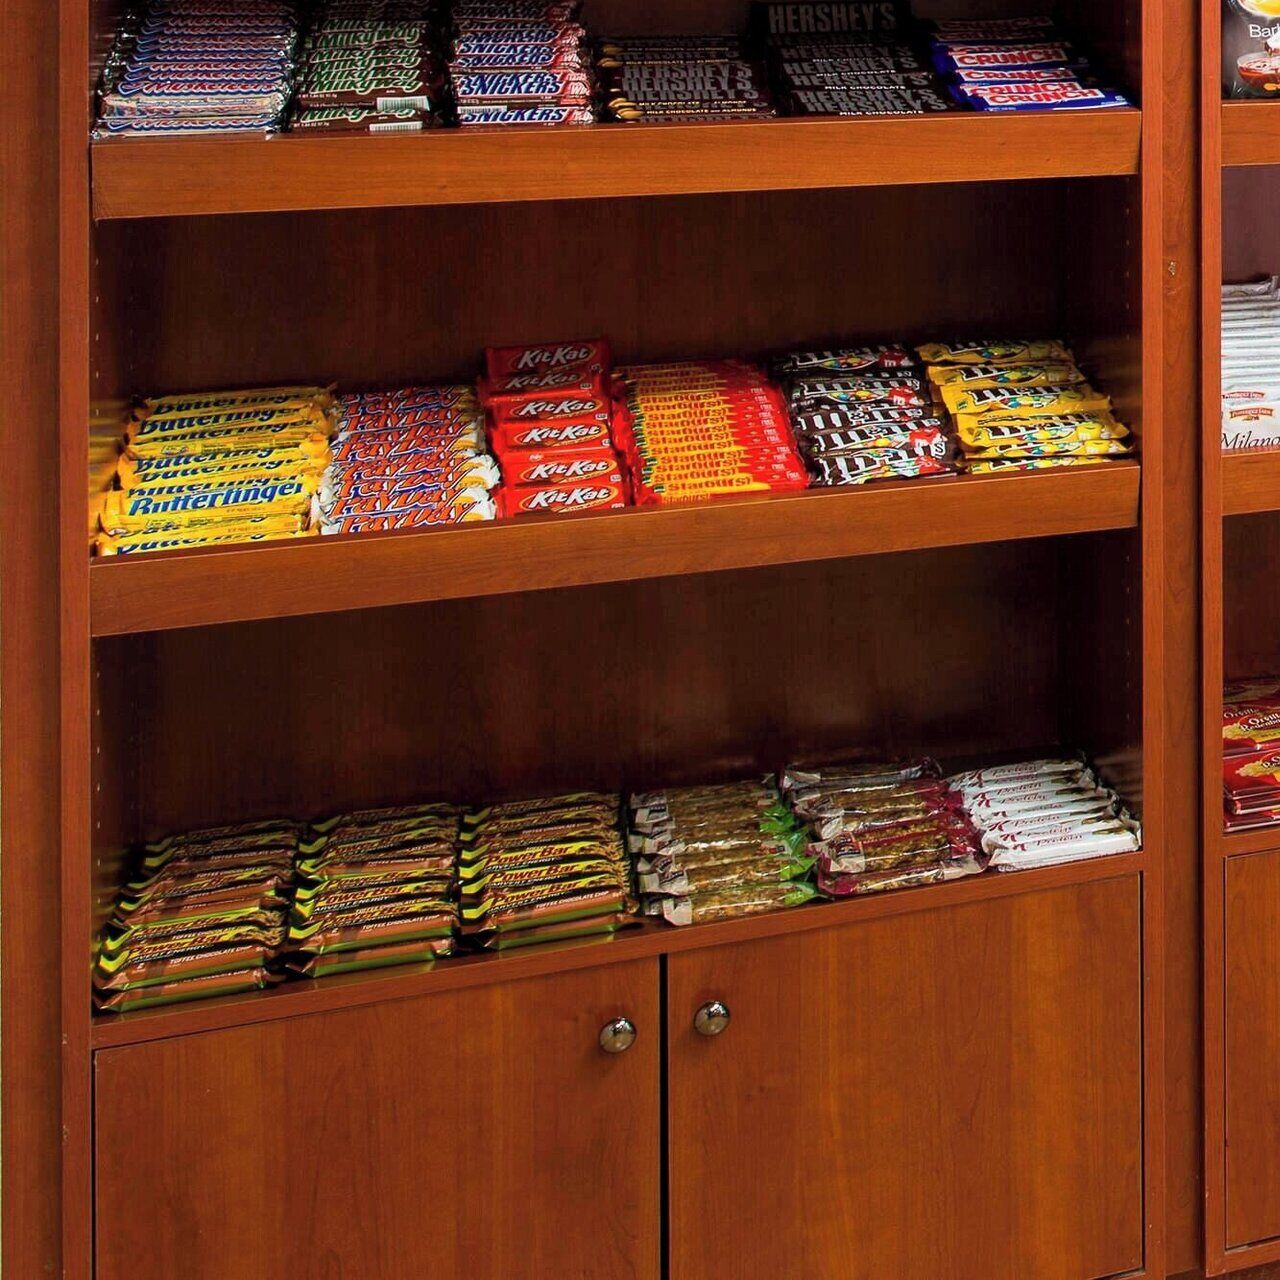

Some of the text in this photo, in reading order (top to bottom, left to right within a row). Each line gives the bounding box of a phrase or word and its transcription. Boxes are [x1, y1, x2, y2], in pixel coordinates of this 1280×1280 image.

[767, 2, 898, 34] HERSHEY'S
[958, 50, 1064, 66] CRUNCH
[460, 81, 564, 96] SNICKERS
[989, 89, 1100, 105] CRUNCH
[461, 107, 568, 123] SNICKERS
[1221, 431, 1280, 450] Milano
[668, 476, 751, 491] Starburst
[128, 482, 303, 517] Butterfinger
[485, 845, 572, 867] PowerBar
[490, 864, 582, 883] PowerBar
